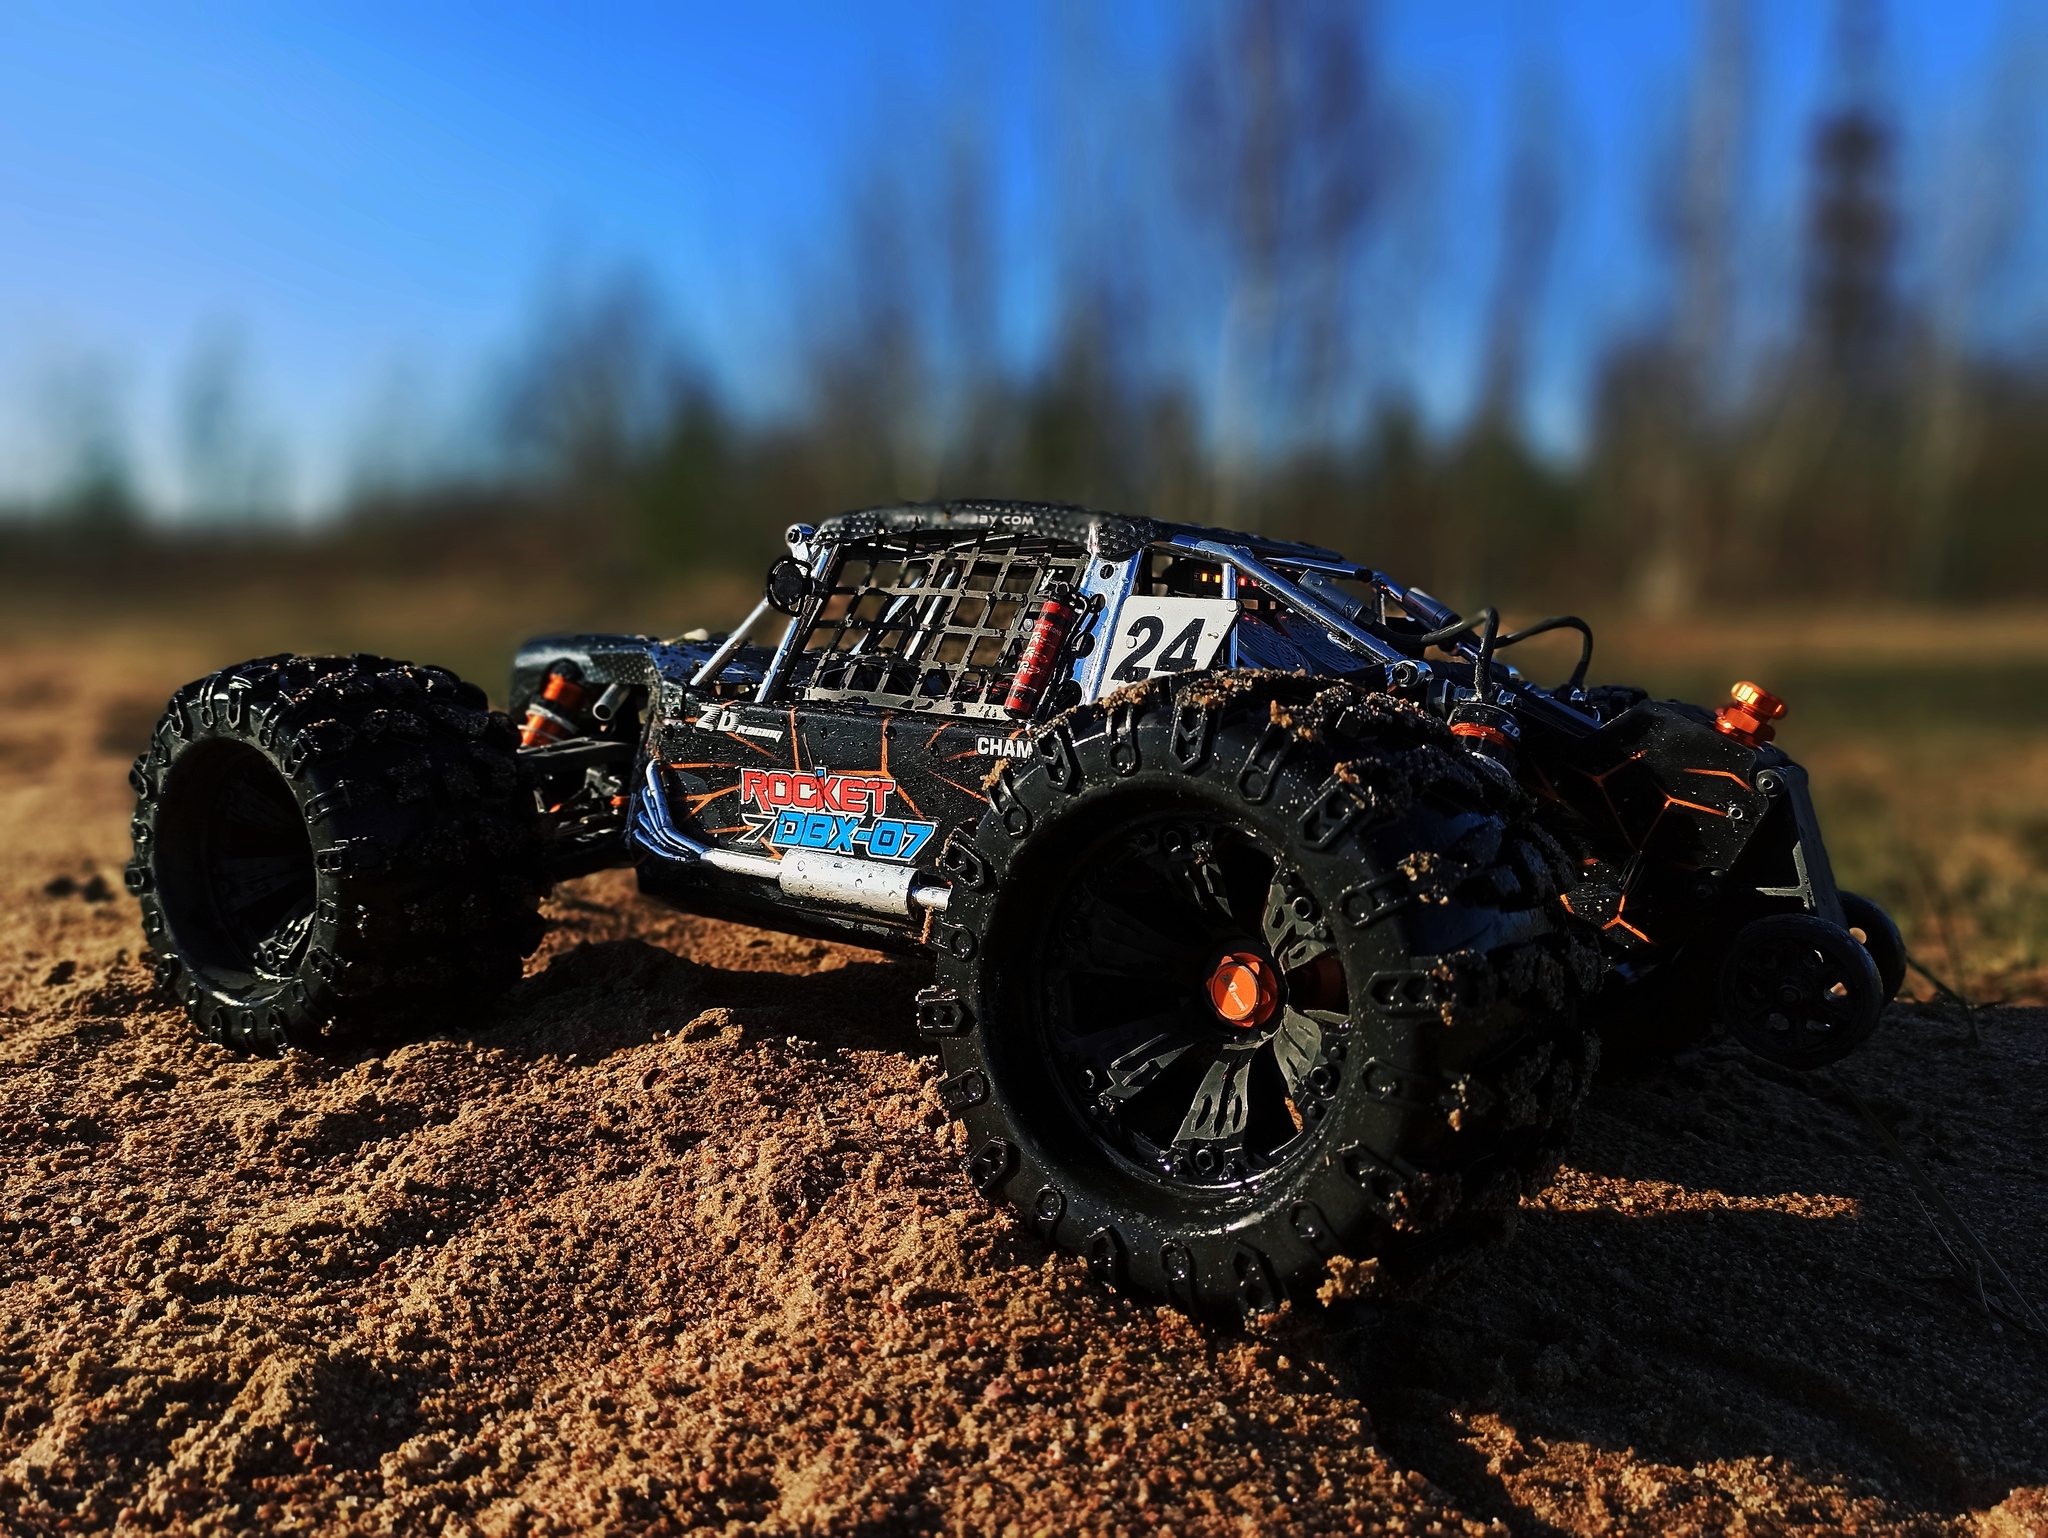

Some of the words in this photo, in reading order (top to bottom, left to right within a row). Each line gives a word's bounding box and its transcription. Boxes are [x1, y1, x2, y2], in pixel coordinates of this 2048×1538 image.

[1110, 615, 1206, 681] 24
[695, 702, 740, 732] ZD
[1502, 719, 1520, 738] ZD
[741, 768, 896, 816] ROCKET
[770, 808, 937, 862] DBX-07
